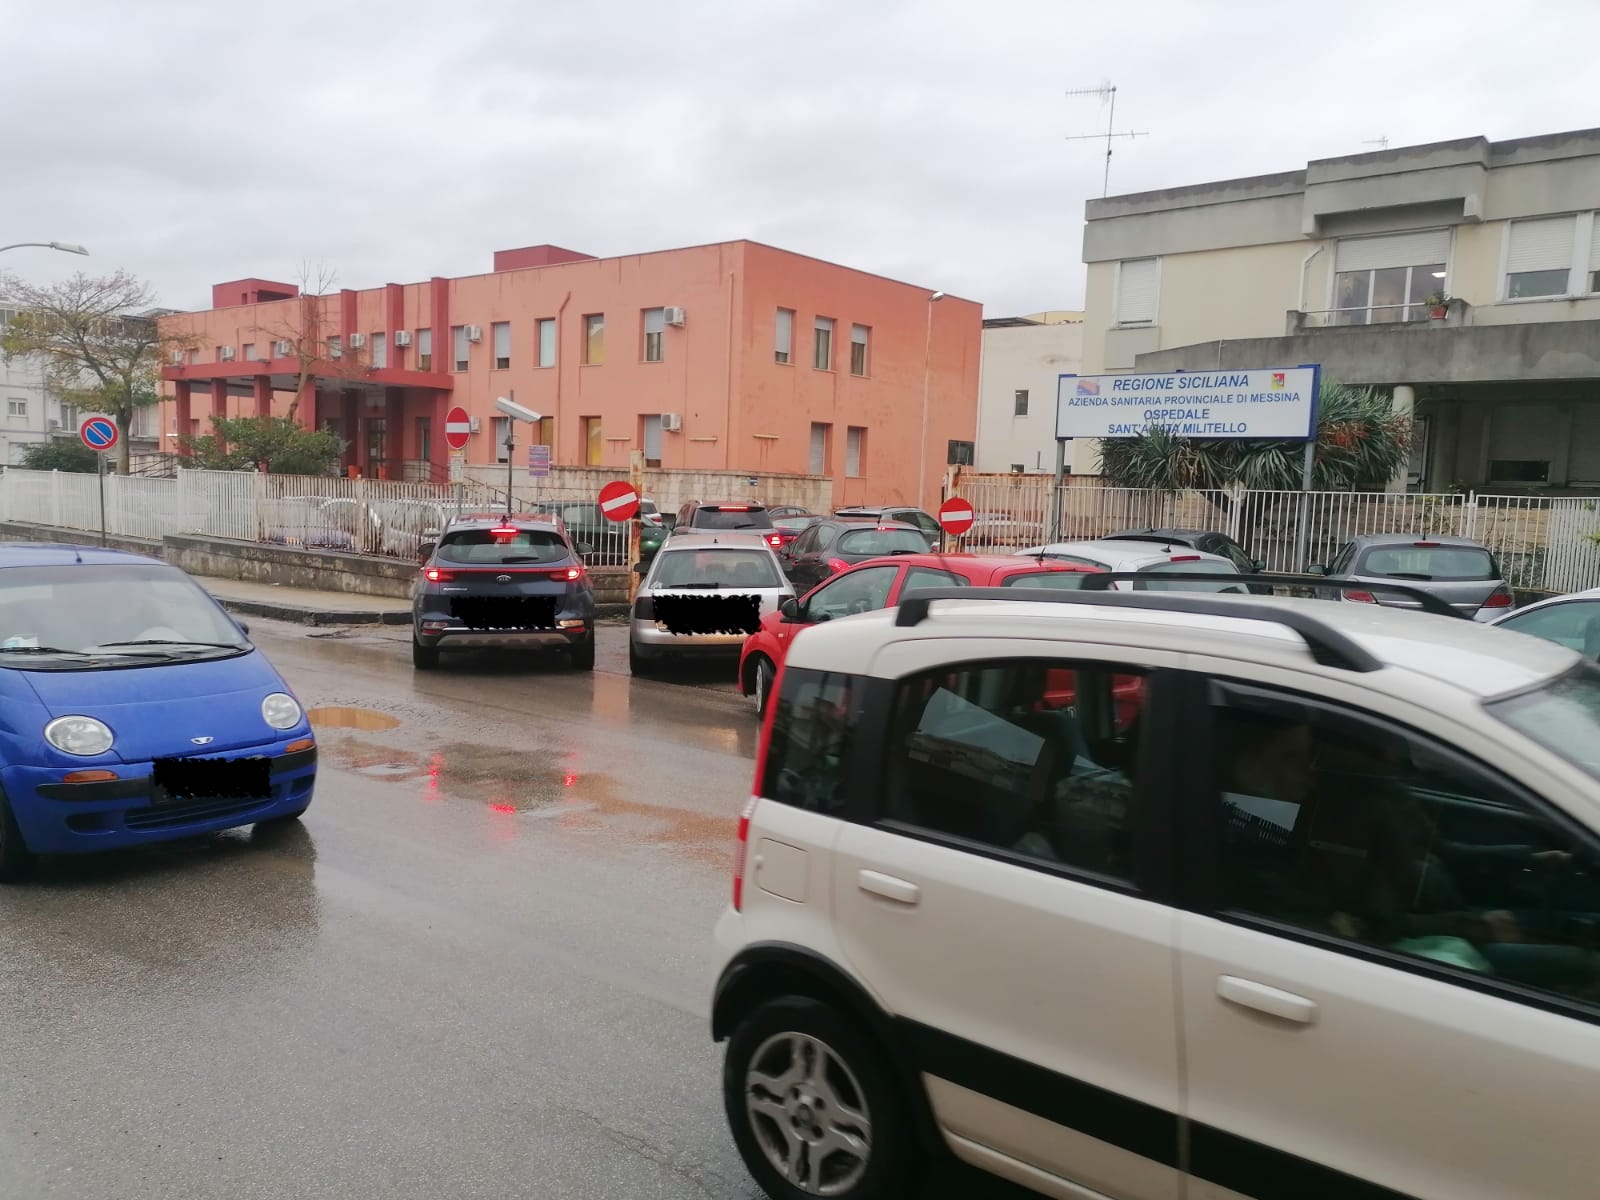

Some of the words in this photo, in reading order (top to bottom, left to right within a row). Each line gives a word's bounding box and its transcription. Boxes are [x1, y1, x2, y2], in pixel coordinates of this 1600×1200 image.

[1113, 377, 1175, 391] REGIONE
[1178, 374, 1249, 389] SICILIANA
[1068, 397, 1108, 406] AZIENDA
[1111, 396, 1161, 406] SANITARIA
[1164, 394, 1233, 405] PROVINCIALE
[1237, 394, 1247, 403] DI
[1250, 392, 1300, 403] MESSINA
[1143, 408, 1210, 420] OSPEDALE
[1182, 422, 1247, 434] MILITELLO
